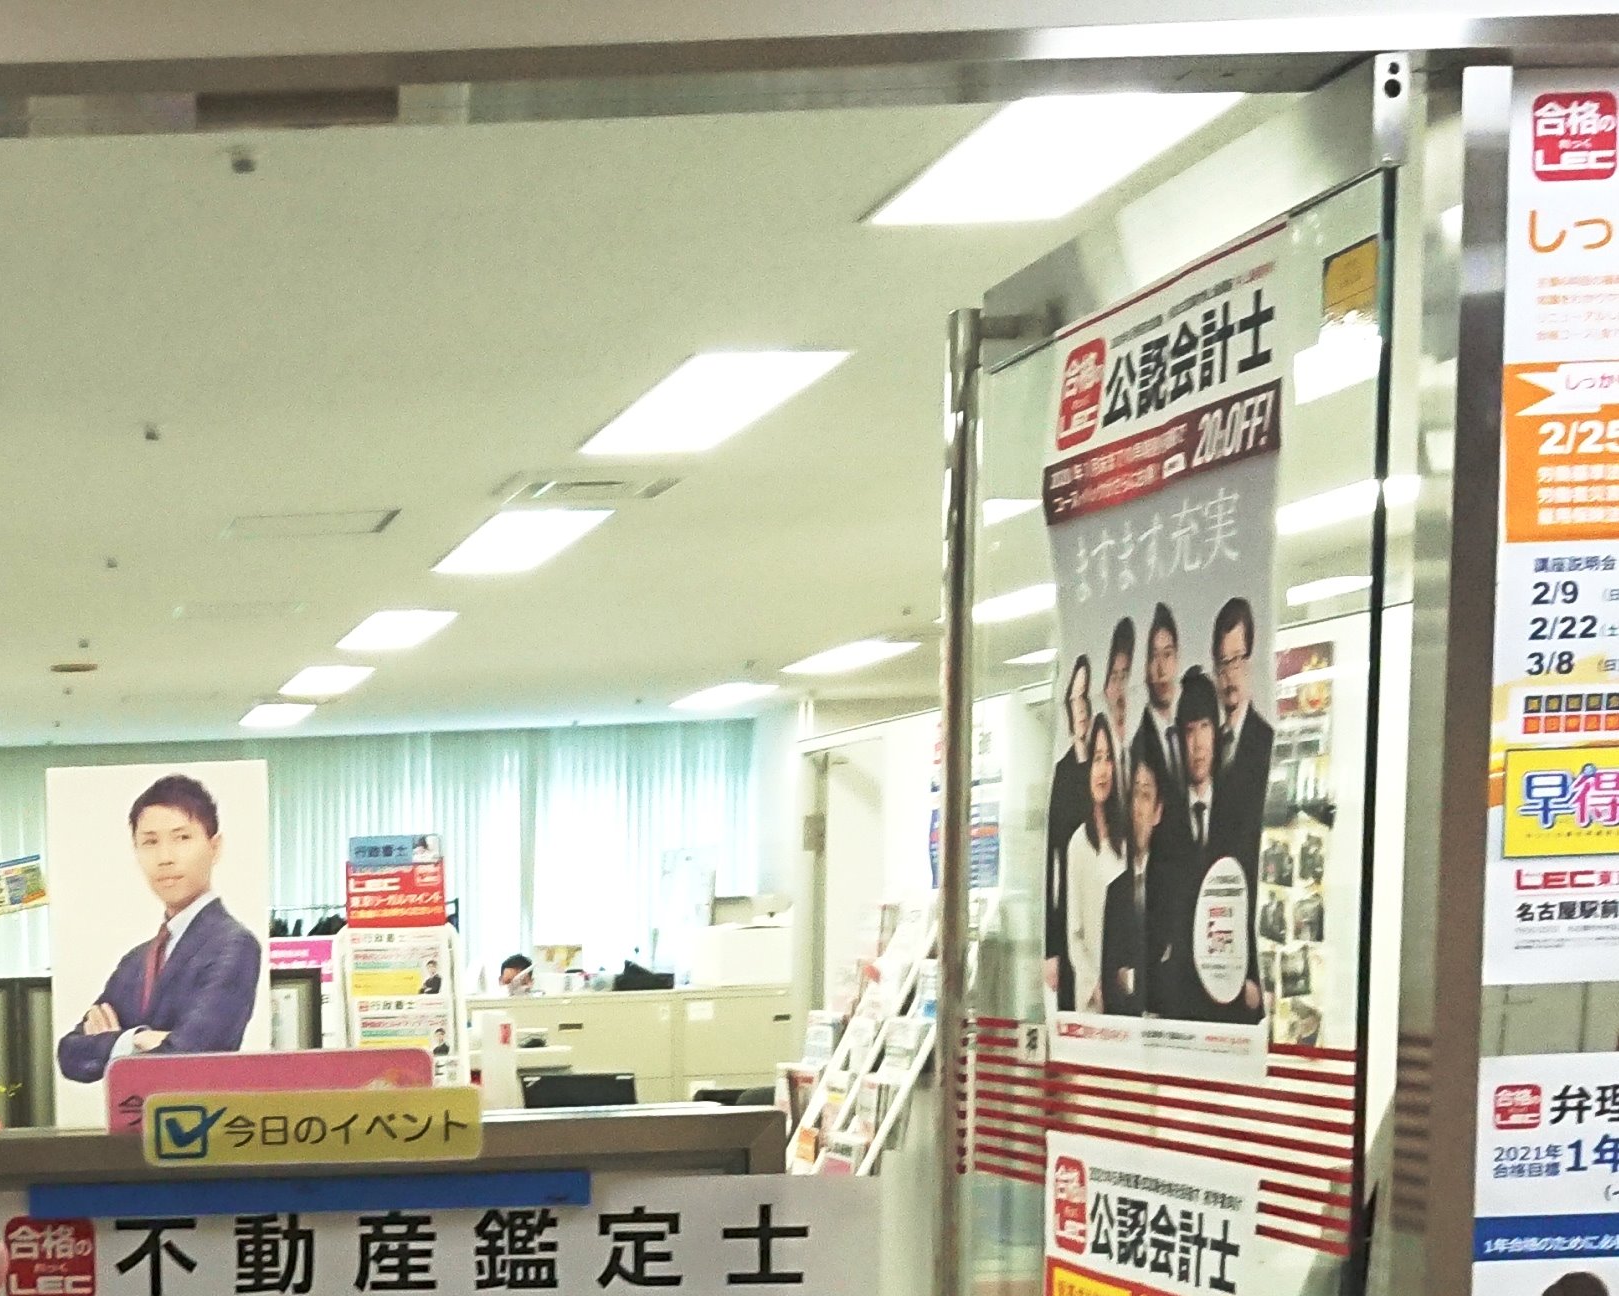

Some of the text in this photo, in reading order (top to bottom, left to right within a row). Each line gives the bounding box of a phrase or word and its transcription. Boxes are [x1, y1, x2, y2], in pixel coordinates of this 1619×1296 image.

[1534, 100, 1616, 137] 合格の
[1534, 149, 1616, 172] LEC
[1102, 288, 1277, 428] 公認会計士
[1530, 580, 1580, 605] 2/9
[1527, 614, 1599, 641] 2/22
[1526, 650, 1575, 676] 3/8
[223, 1109, 469, 1149] 今日のイベント
[1493, 1146, 1561, 1163] 2021年
[8, 1225, 93, 1261] 合格の
[1090, 1191, 1241, 1295] 公認会計士
[9, 1273, 93, 1296] LEC
